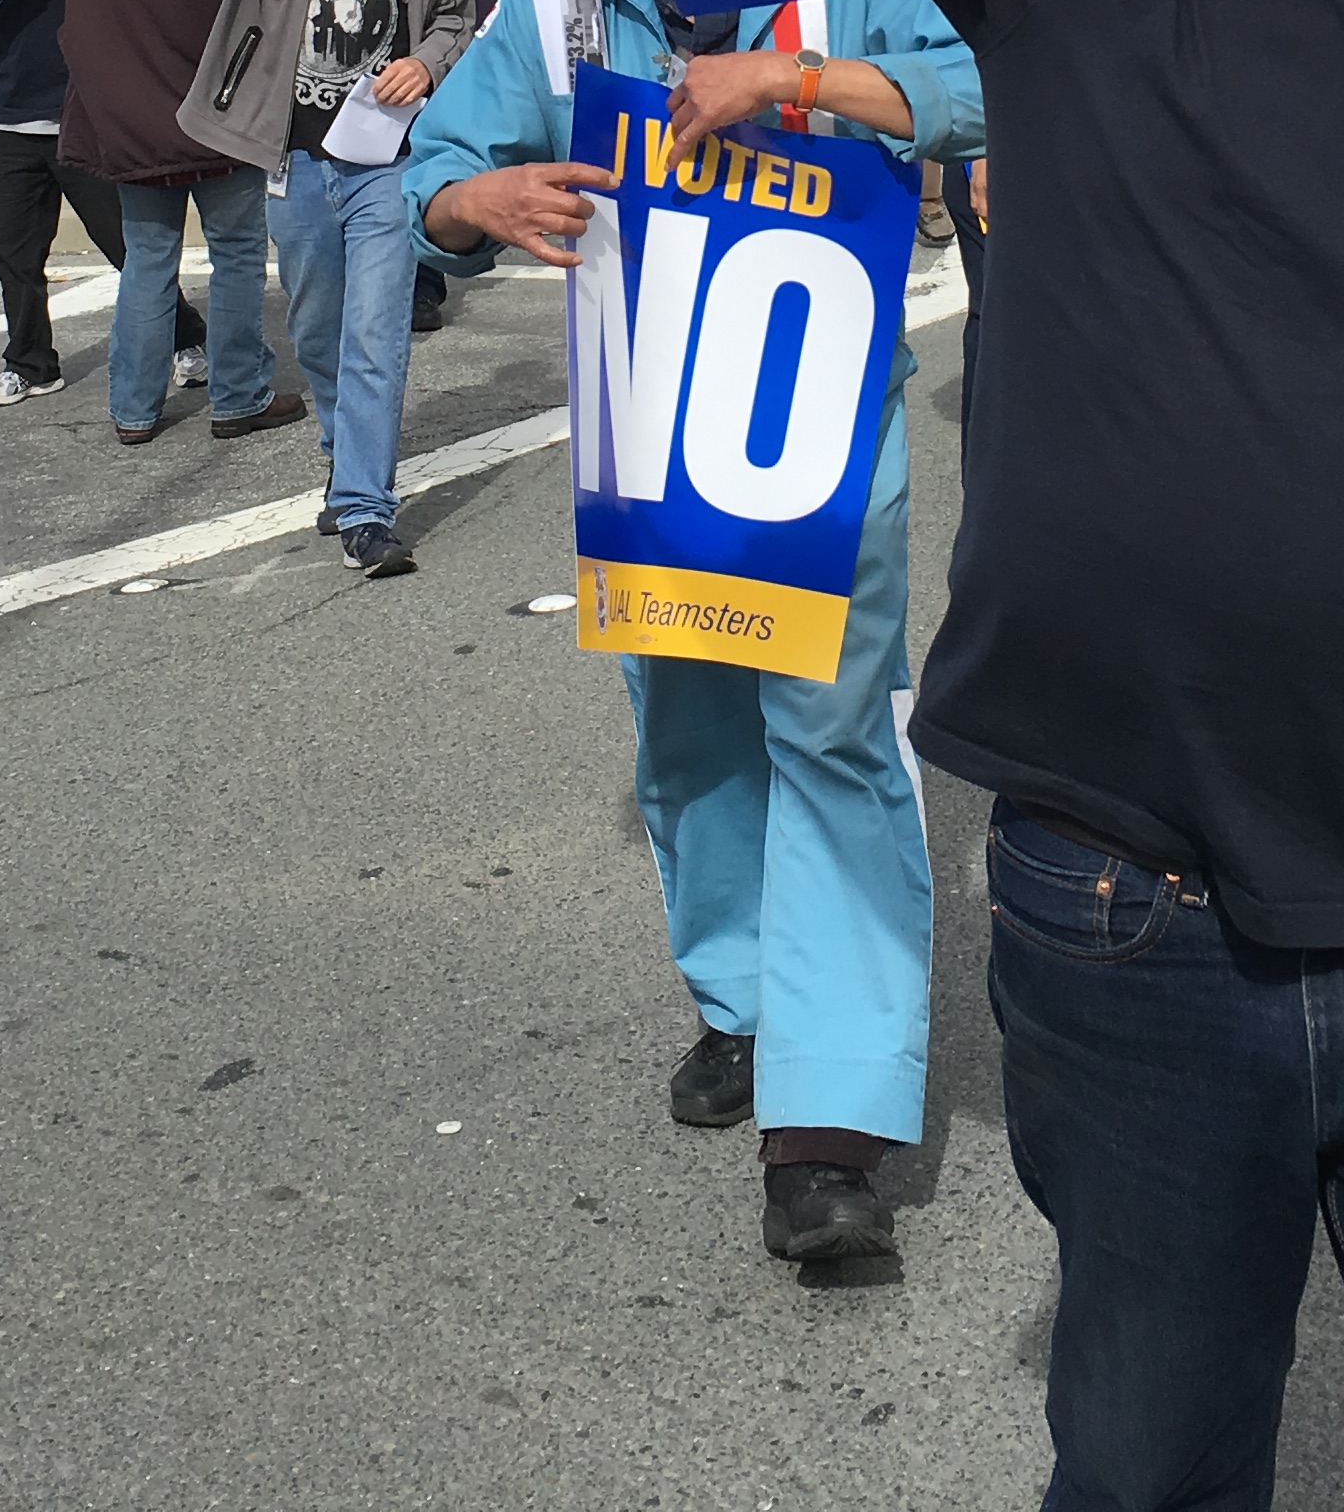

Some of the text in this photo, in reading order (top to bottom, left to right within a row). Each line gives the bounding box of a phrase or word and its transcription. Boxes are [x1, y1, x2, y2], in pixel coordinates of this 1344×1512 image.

[613, 111, 833, 219] I VOTED
[578, 190, 875, 523] NO
[609, 588, 775, 641] UAL Teamsters
